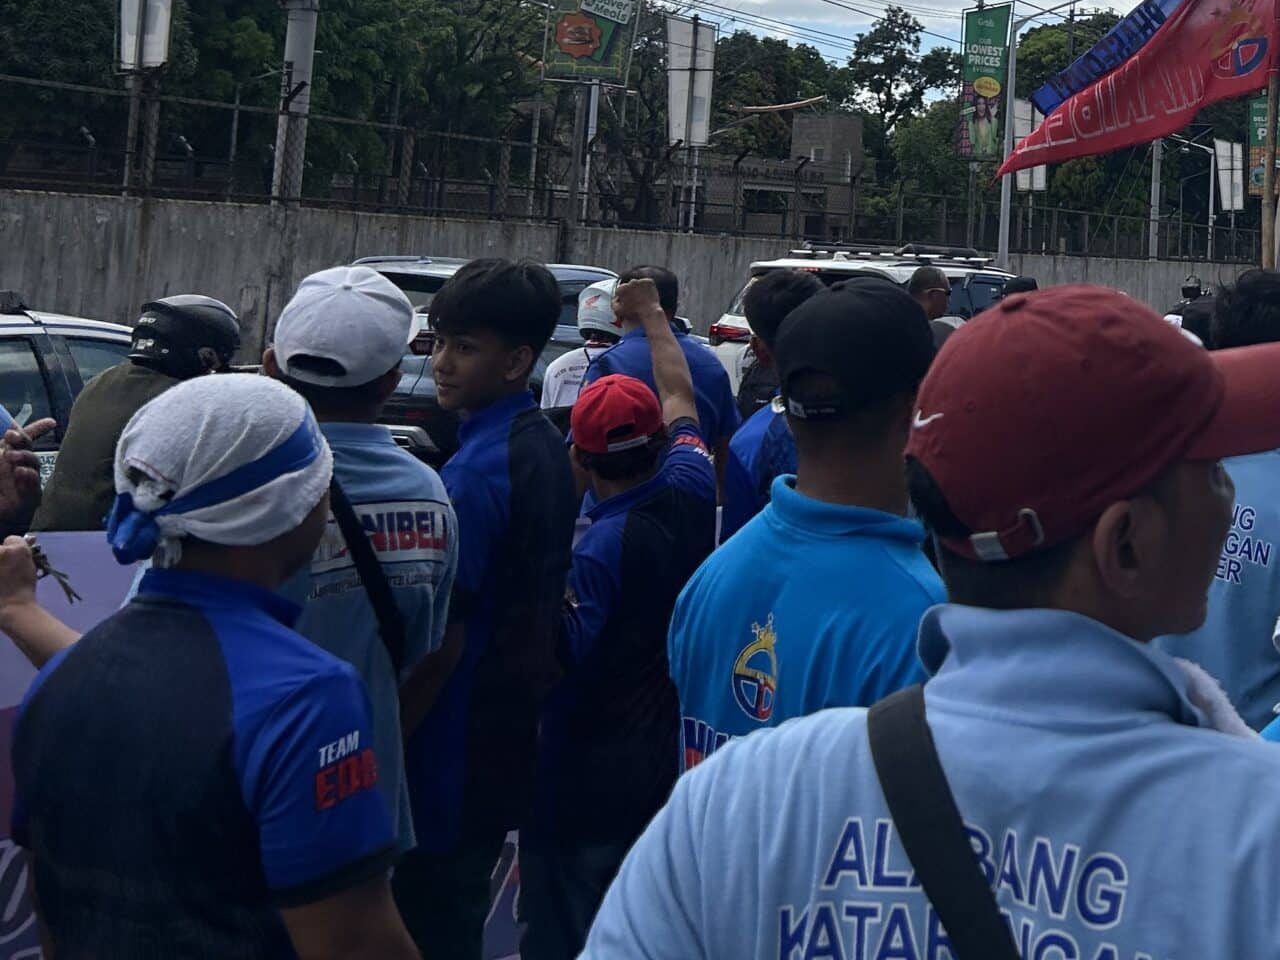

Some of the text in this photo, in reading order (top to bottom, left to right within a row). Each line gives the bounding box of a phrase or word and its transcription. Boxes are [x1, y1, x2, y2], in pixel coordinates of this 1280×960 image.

[593, 1, 628, 23] Meals
[966, 44, 1004, 57] LOWEST
[968, 55, 1001, 68] PRICES
[318, 730, 360, 768] TEAM
[822, 816, 1128, 930] ALBANG
